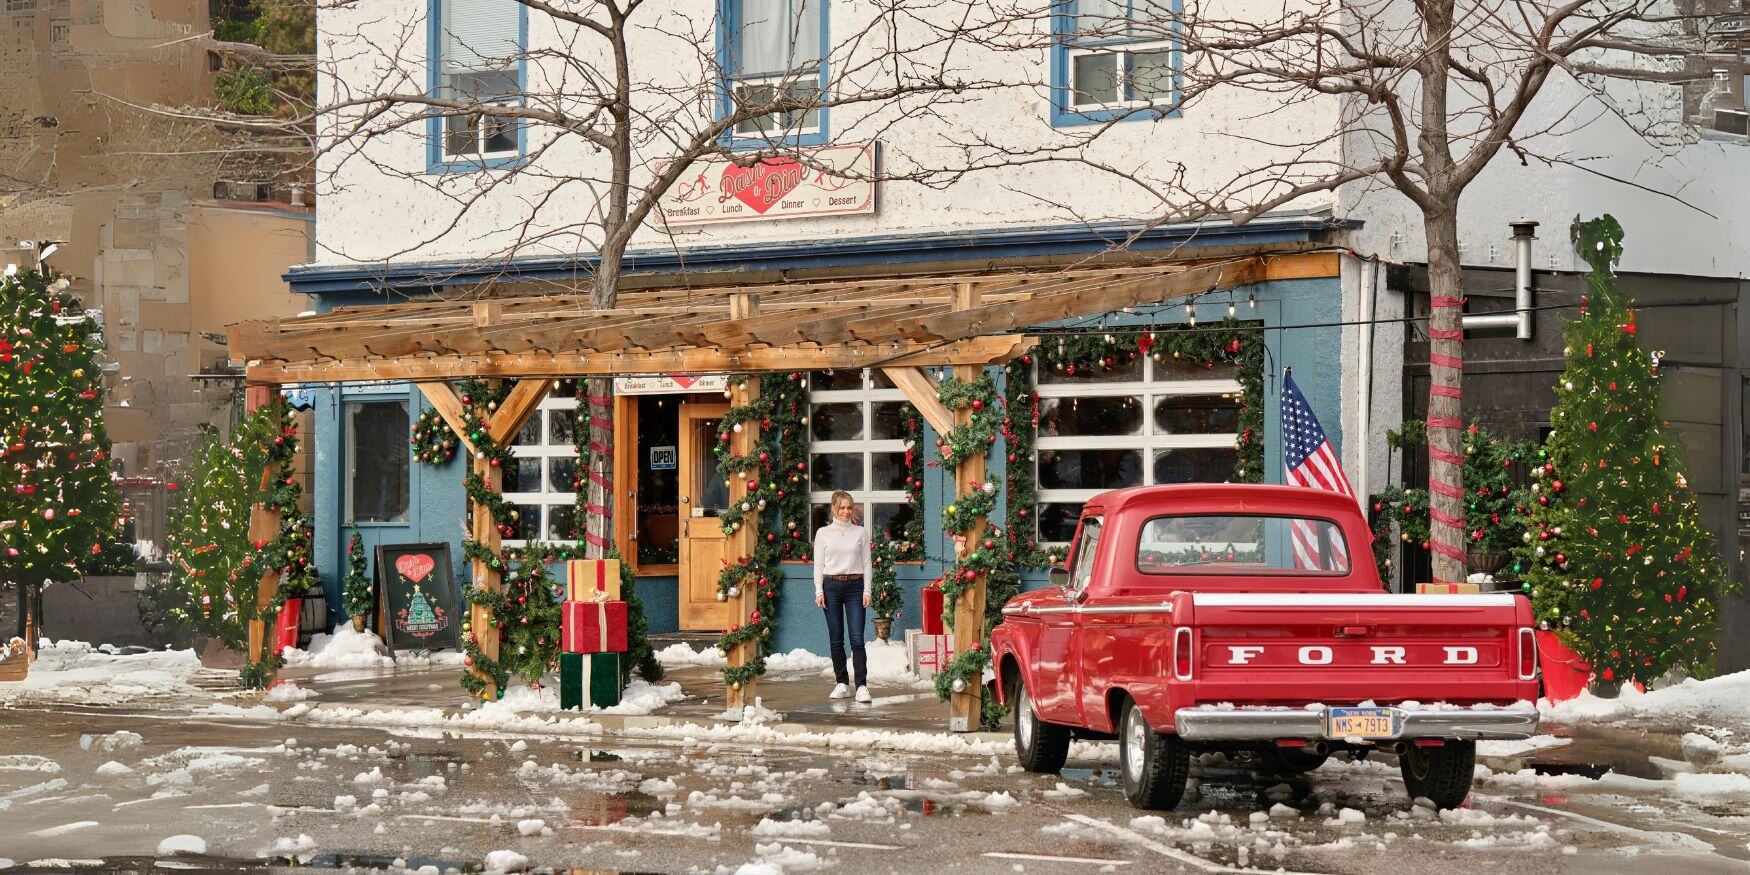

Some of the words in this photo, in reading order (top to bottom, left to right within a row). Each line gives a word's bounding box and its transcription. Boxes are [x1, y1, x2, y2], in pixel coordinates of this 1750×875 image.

[764, 164, 810, 204] Dine
[753, 186, 761, 197] Or
[667, 206, 700, 217] Breakfast
[722, 204, 743, 214] Lunch
[782, 200, 804, 209] Dinner
[829, 196, 856, 206] Dessert
[653, 450, 674, 464] OPEN
[1228, 646, 1478, 665] FORD
[1345, 709, 1360, 717] NEW
[1361, 709, 1377, 717] YORK
[1364, 718, 1388, 732] 79T3
